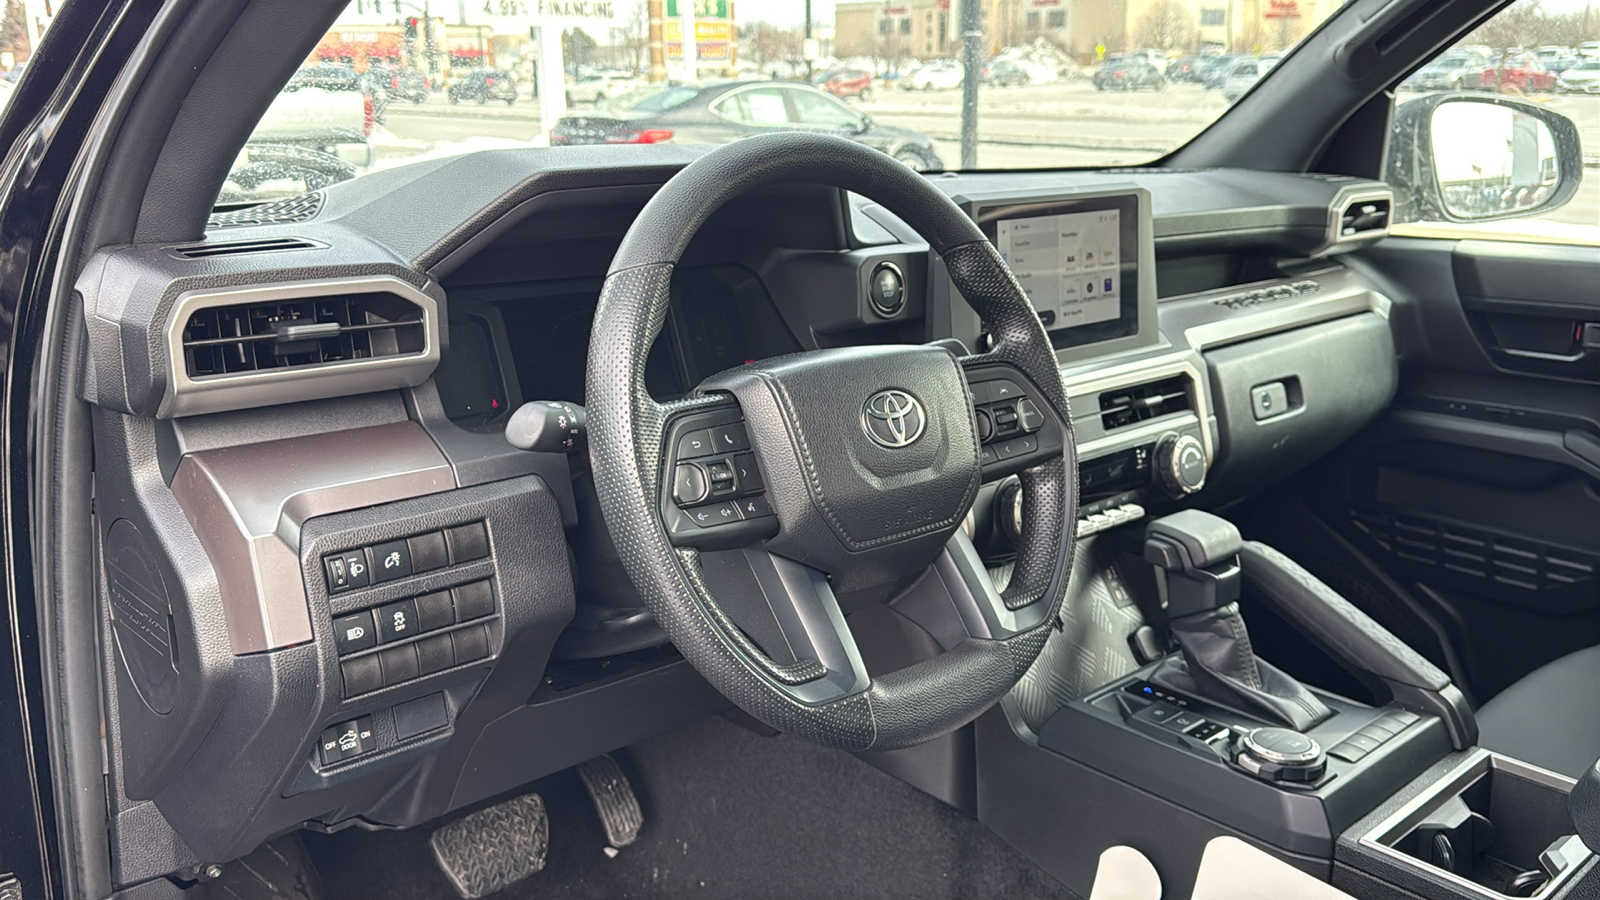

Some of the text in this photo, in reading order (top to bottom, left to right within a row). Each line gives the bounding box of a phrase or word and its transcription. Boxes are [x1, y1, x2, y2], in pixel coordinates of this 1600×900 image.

[538, 0, 614, 18] FINANCING
[394, 624, 406, 632] OFF
[360, 730, 371, 739] ON
[324, 740, 337, 750] OFF
[341, 741, 357, 751] DOOR
